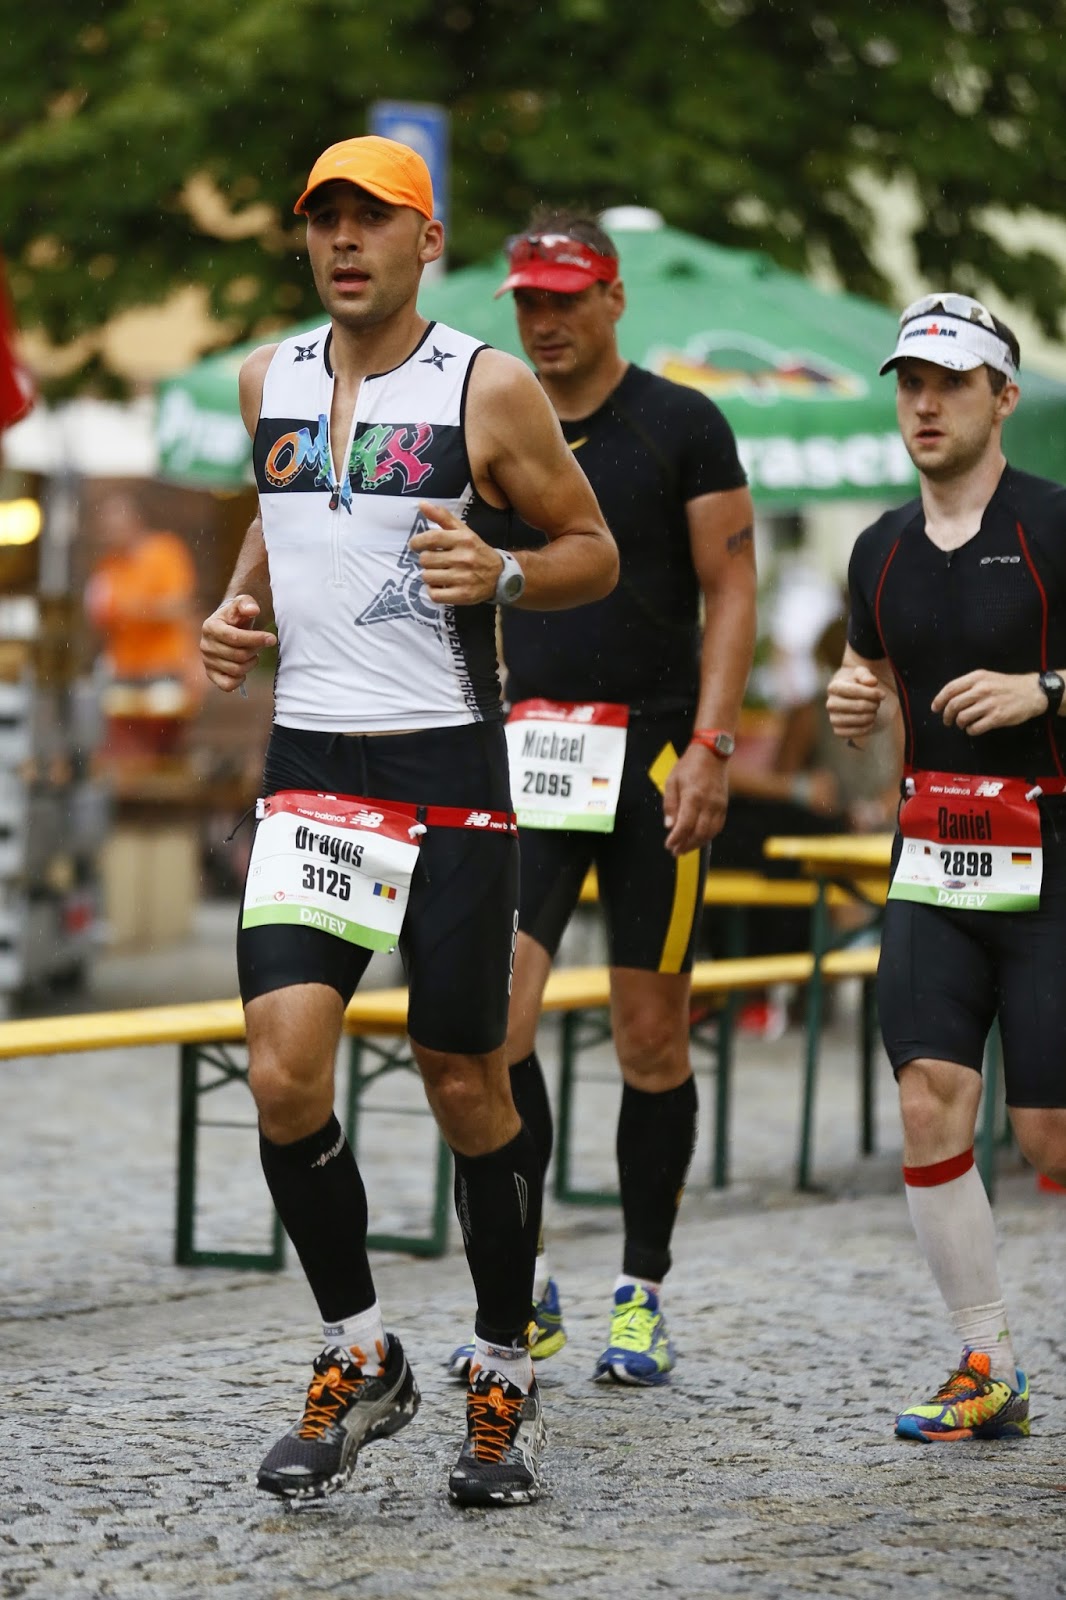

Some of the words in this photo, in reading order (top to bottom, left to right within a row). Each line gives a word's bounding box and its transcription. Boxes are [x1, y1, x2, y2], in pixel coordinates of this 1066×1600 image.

[522, 730, 585, 763] Michael
[522, 771, 573, 797] 2095
[930, 785, 943, 793] new
[944, 786, 971, 795] balance
[297, 807, 315, 817] new
[315, 811, 347, 823] balance
[938, 807, 992, 840] Daniel
[295, 825, 365, 868] Dragos
[940, 851, 993, 877] 2898
[302, 863, 352, 901] 3125
[937, 890, 988, 907] DATEV
[300, 907, 347, 935] DATEV
